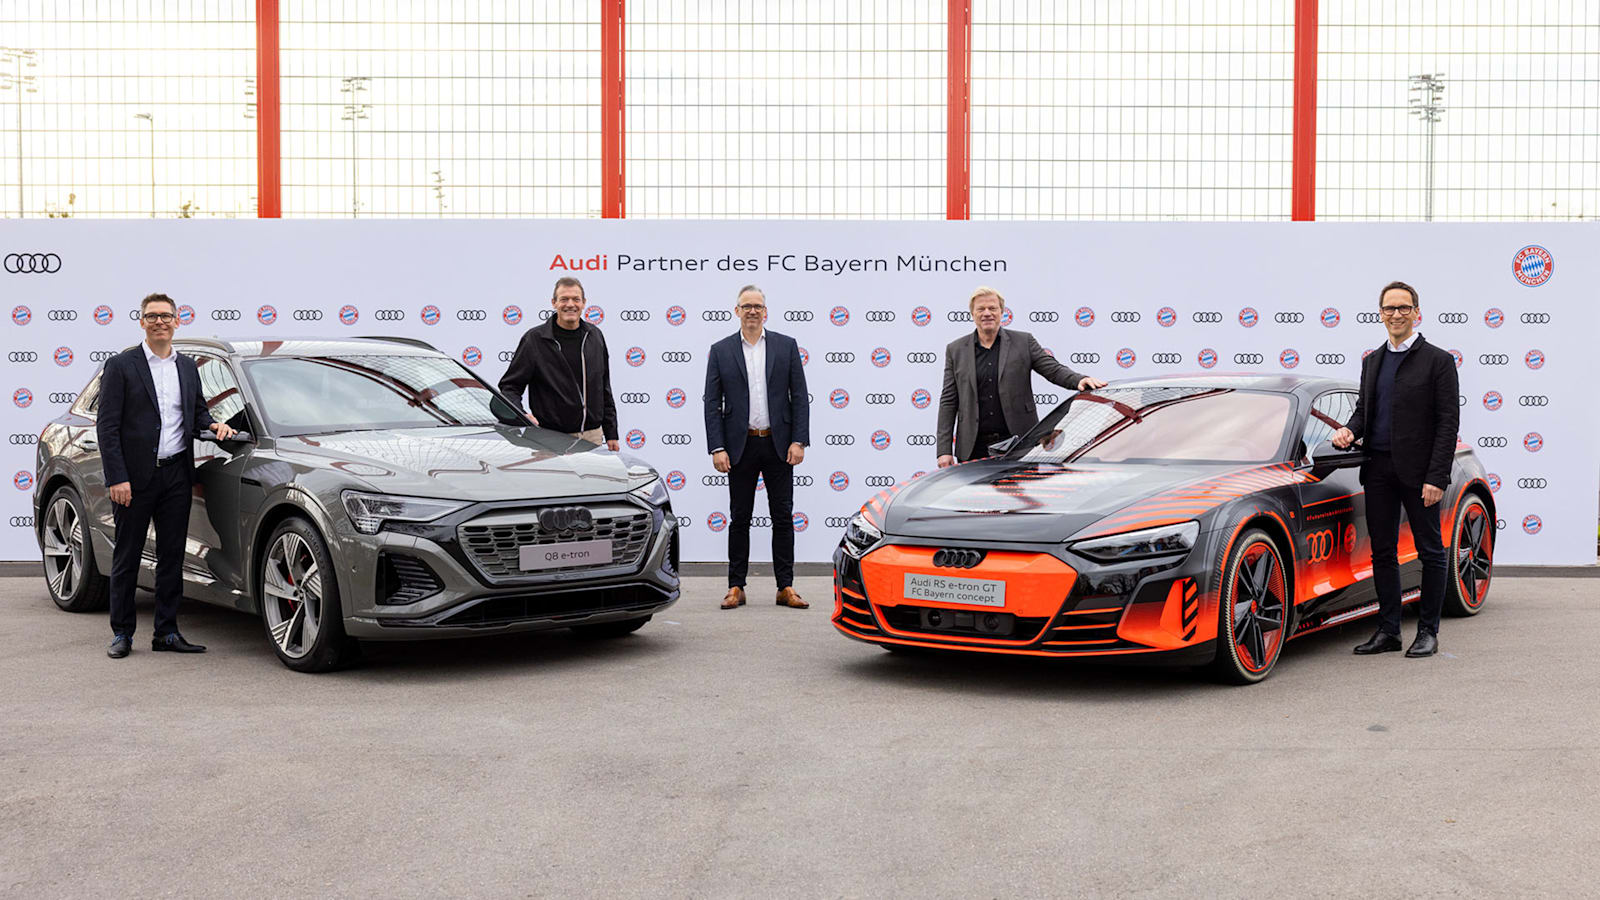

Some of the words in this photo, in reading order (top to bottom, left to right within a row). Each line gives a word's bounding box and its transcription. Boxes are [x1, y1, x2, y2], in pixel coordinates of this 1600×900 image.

[1524, 248, 1551, 264] BAYERN
[549, 254, 608, 271] Audi
[617, 255, 710, 271] Partner
[716, 255, 759, 271] des
[767, 255, 797, 271] FC
[804, 255, 888, 276] Bayern
[897, 255, 1007, 271] München
[544, 552, 559, 561] Q8
[561, 551, 590, 559] e-tron
[910, 577, 931, 587] Audi
[933, 580, 946, 588] RS
[948, 582, 979, 591] e-tron
[982, 583, 997, 593] GT
[911, 587, 923, 597] FC
[924, 588, 954, 599] Bayern
[956, 593, 995, 603] concept
